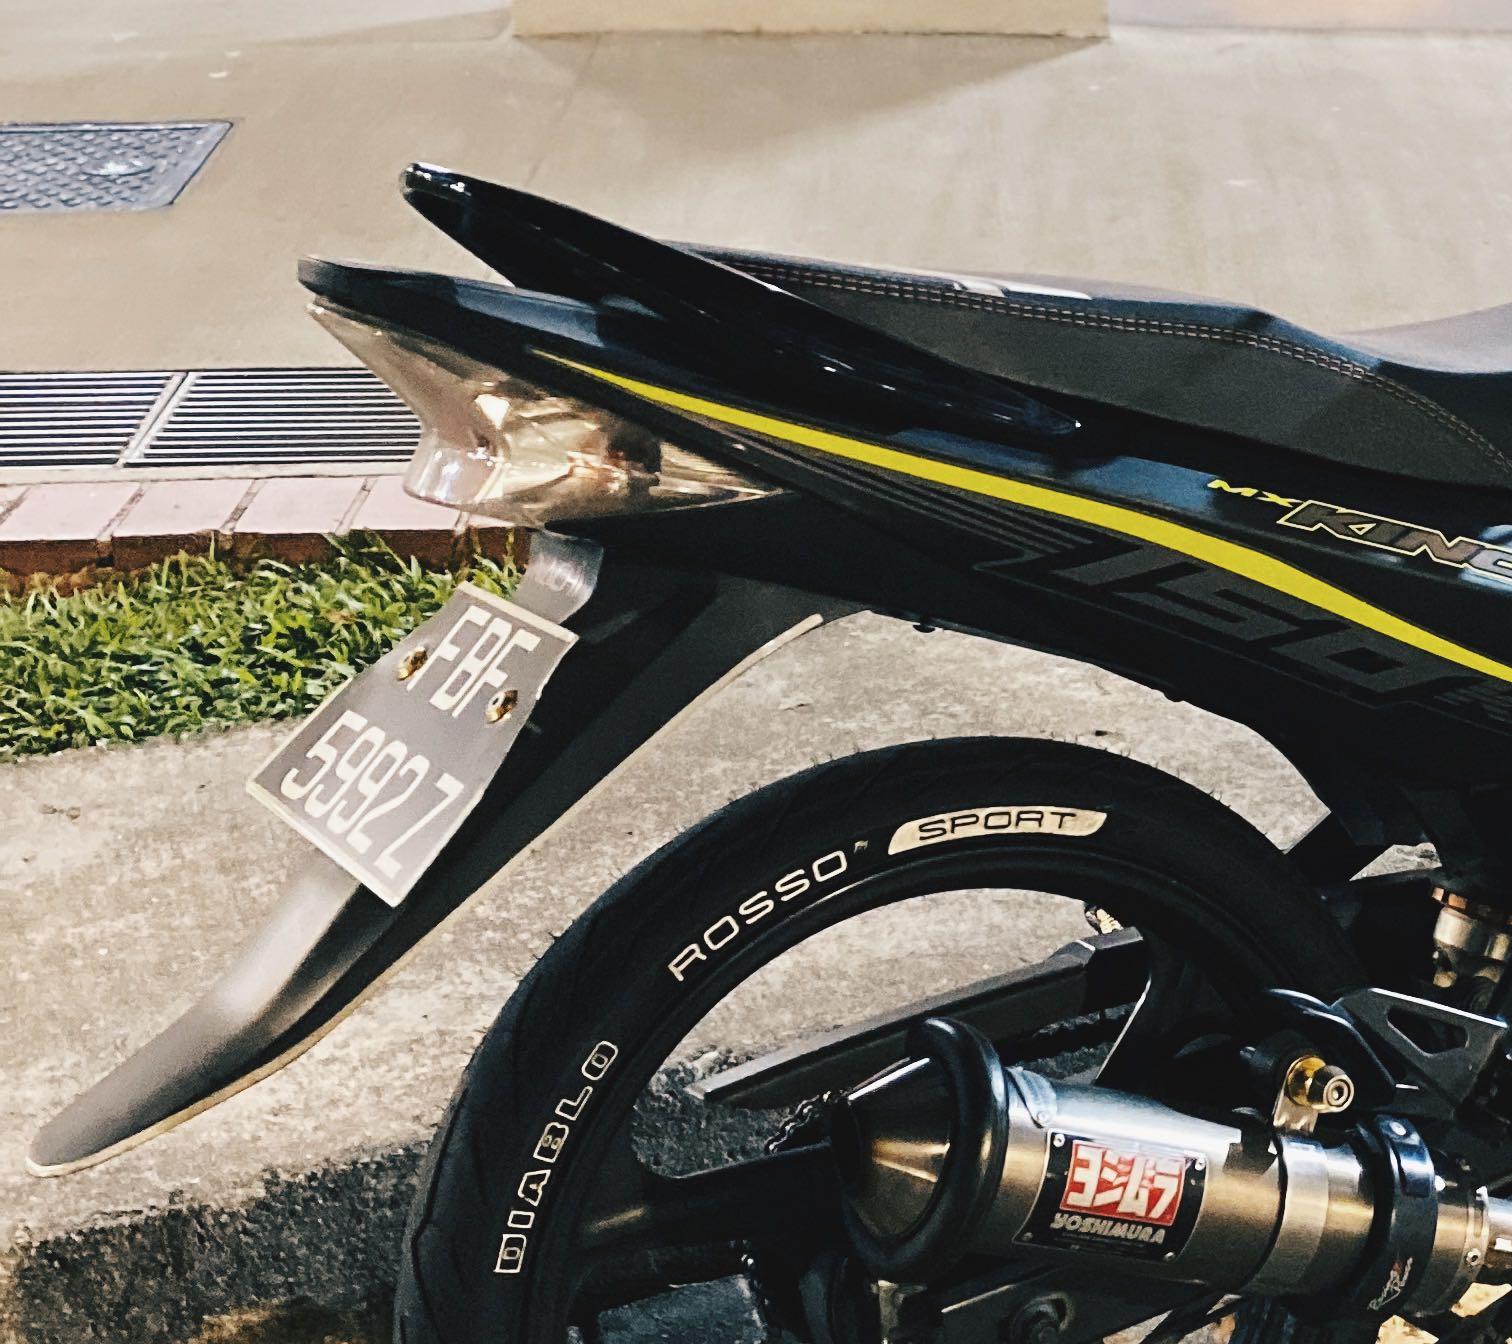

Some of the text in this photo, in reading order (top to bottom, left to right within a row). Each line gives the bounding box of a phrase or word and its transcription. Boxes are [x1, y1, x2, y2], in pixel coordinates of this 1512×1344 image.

[1207, 479, 1303, 508] MX
[406, 604, 541, 718] FBF
[494, 809, 1078, 1274] DIABLO ROSSO SPORT
[1050, 1212, 1166, 1245] YOSHIMURA
